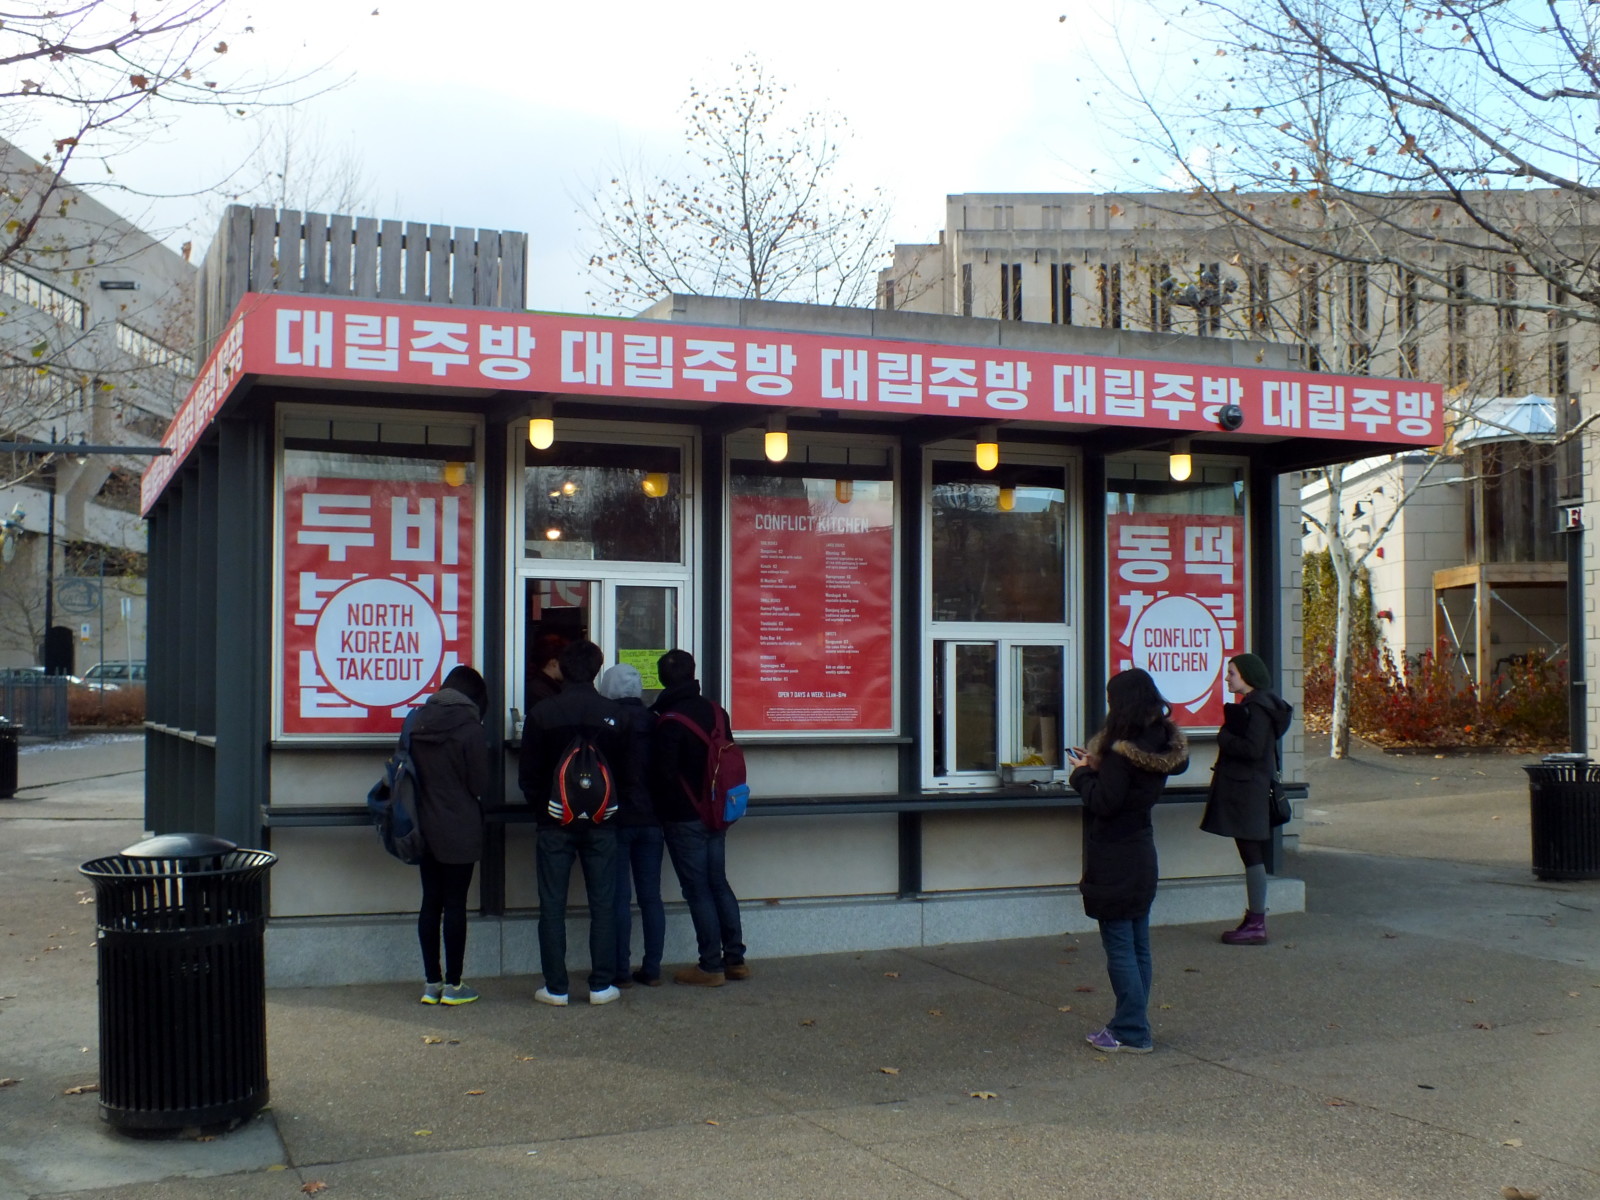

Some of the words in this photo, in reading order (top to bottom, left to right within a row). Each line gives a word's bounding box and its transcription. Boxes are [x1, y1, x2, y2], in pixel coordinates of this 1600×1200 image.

[275, 308, 536, 381] 대립주방
[560, 329, 798, 396] 대립주방
[820, 348, 1032, 411] 대립주방
[1053, 364, 1244, 424] 대립주방
[1262, 380, 1435, 437] 대립주방
[755, 514, 815, 530] CONFLICT
[818, 517, 869, 532] KITCHEN
[347, 603, 414, 627] NORTH
[341, 630, 419, 654] KOREAN
[1144, 628, 1211, 648] CONFLICT
[336, 657, 424, 681] TAKEOUT
[1148, 652, 1208, 672] KITCHEN
